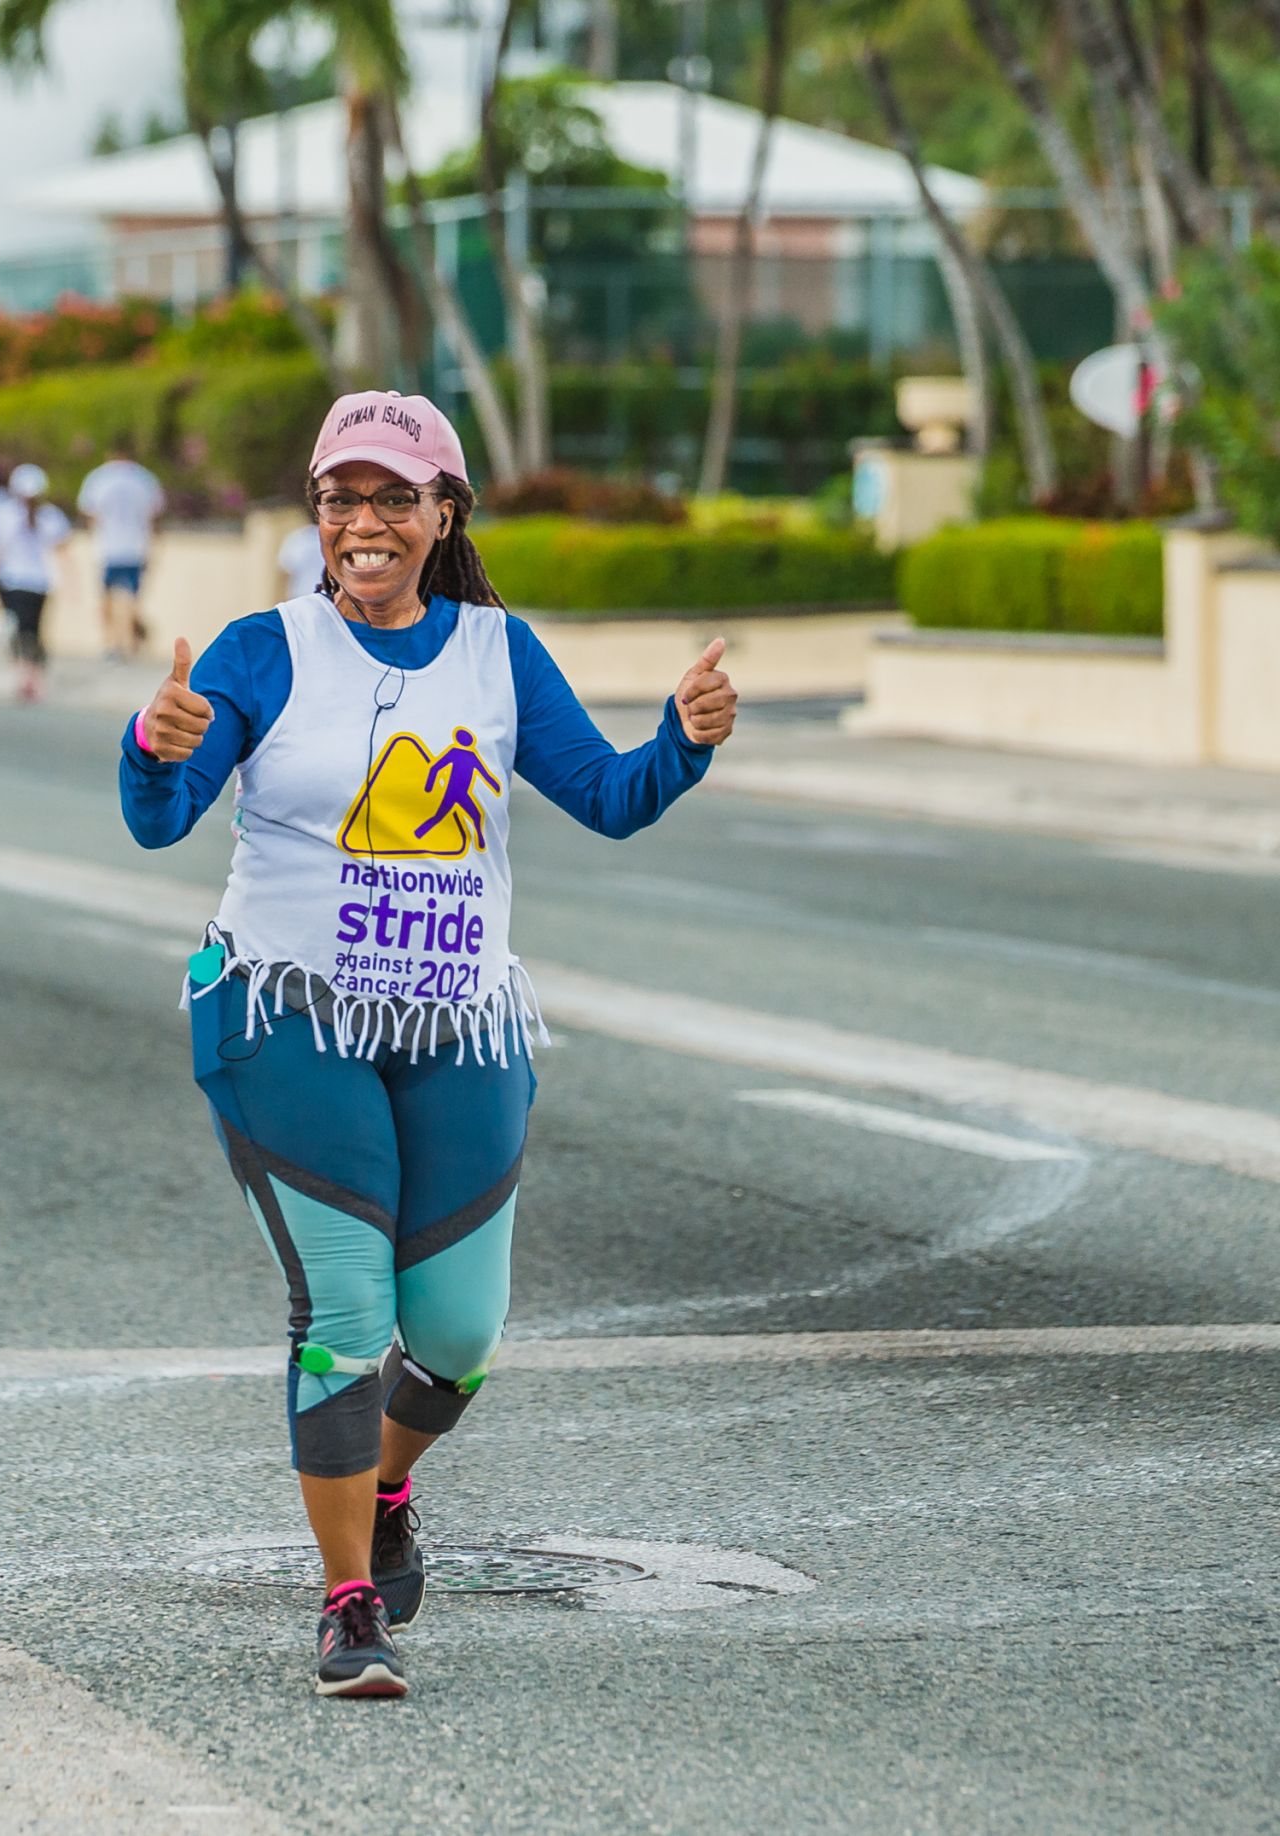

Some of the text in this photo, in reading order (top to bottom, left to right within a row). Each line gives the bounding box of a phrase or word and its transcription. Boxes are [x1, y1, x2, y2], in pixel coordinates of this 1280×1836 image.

[337, 405, 421, 442] CAYMAN ISLANDS
[340, 863, 483, 898] nationwide
[336, 893, 483, 955] stride
[334, 960, 480, 1002] cancer 2021
[335, 952, 413, 975] against
